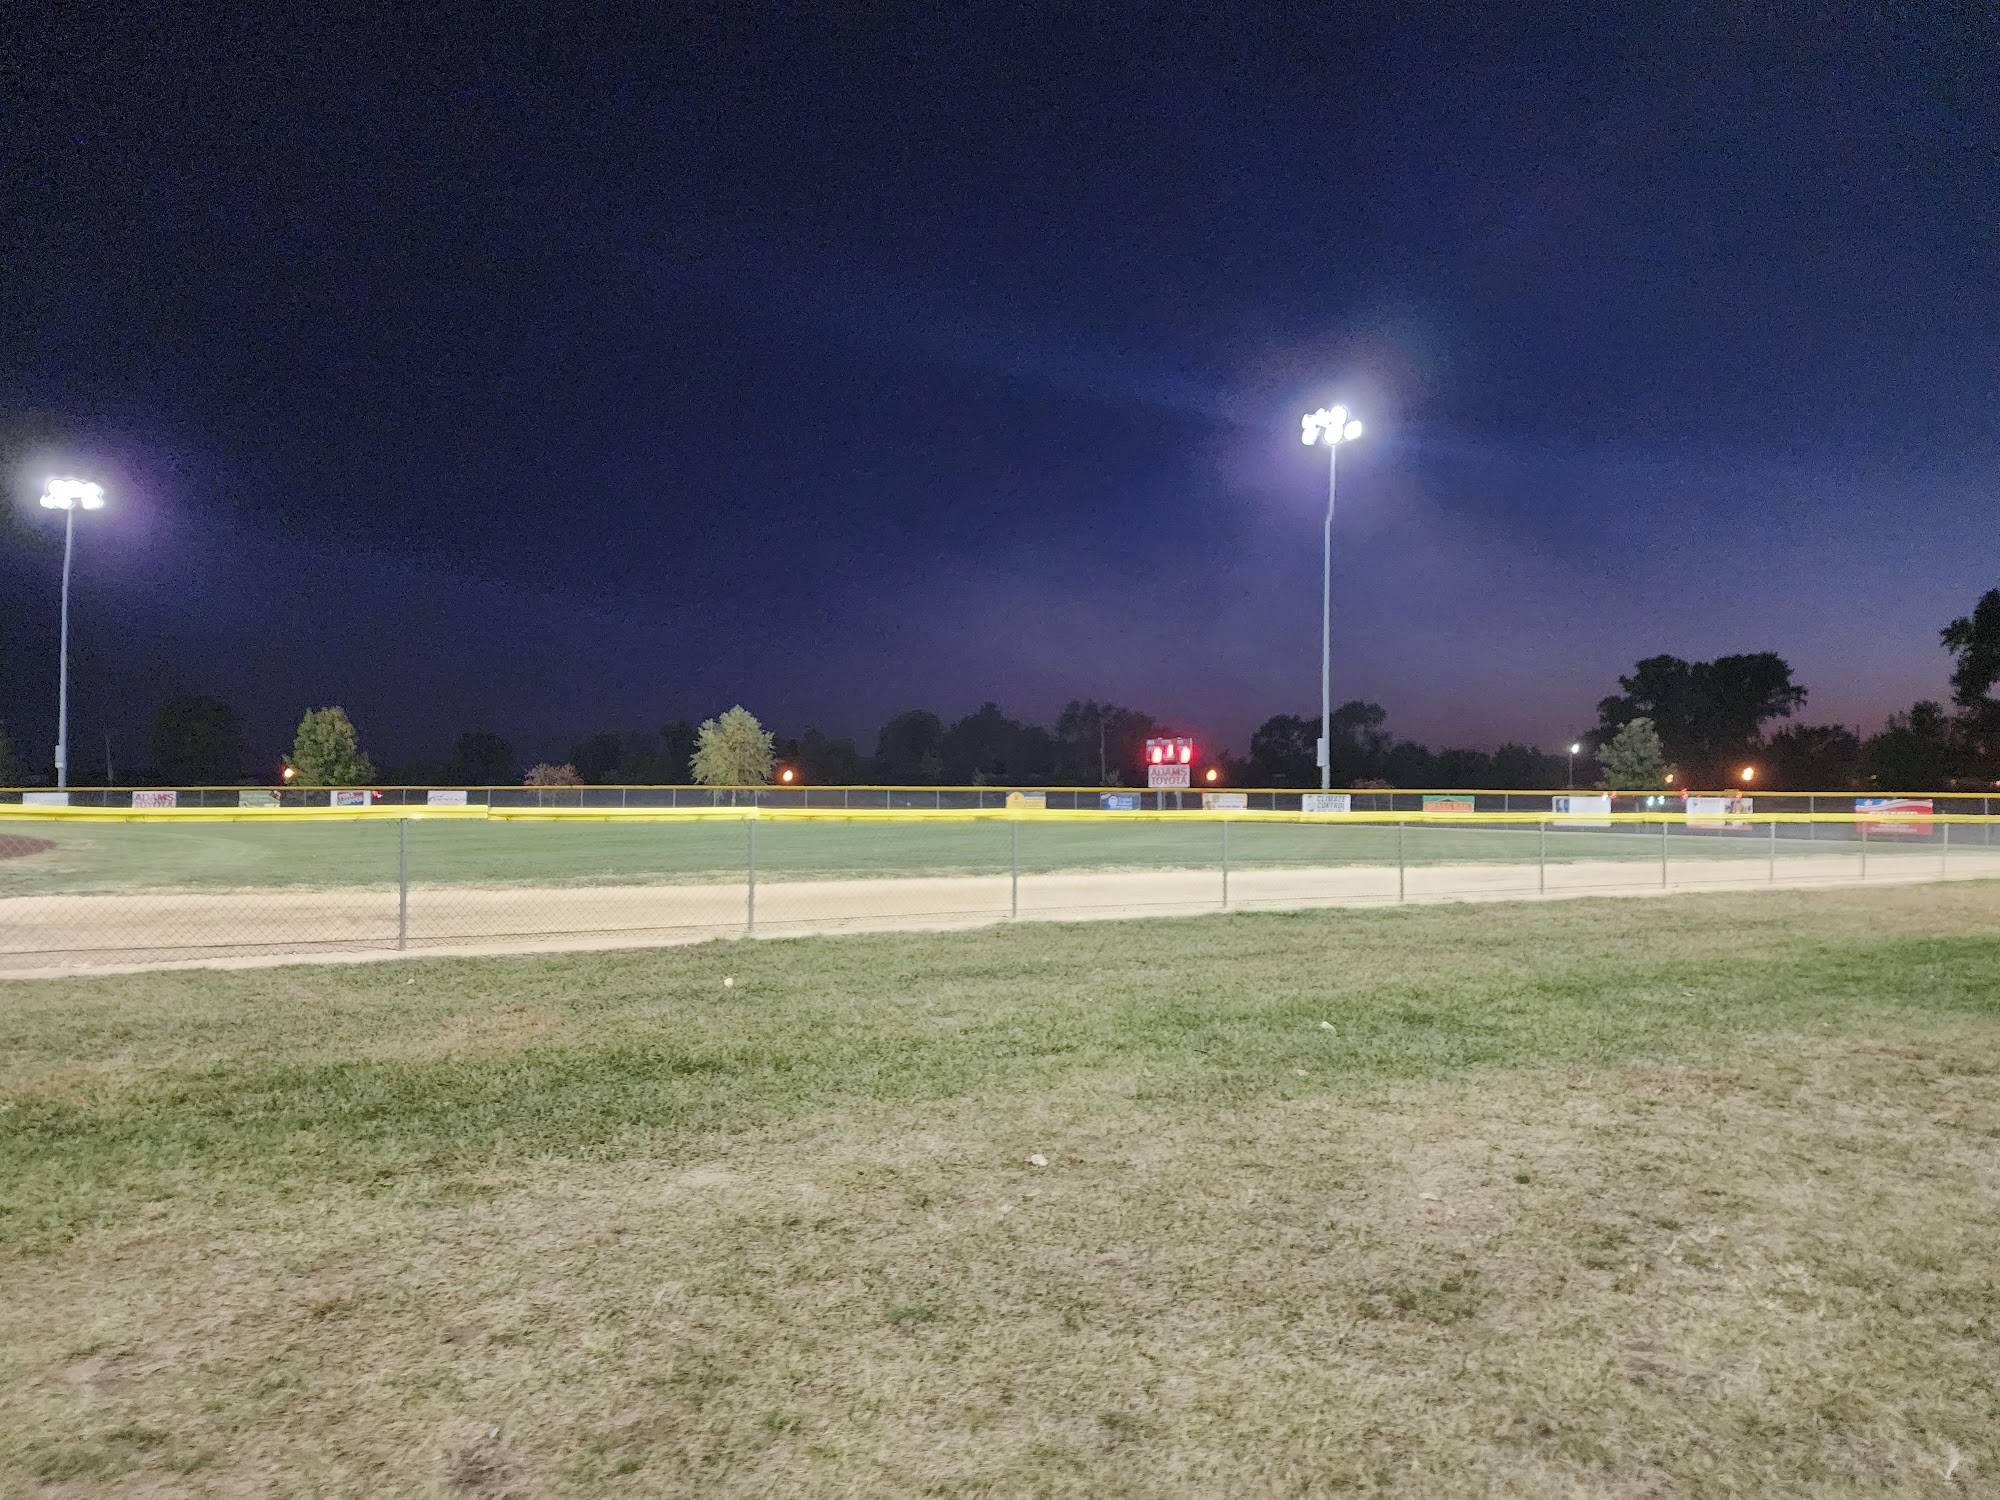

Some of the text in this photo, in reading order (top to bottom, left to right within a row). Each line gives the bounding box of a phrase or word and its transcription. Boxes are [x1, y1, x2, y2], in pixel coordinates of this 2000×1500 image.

[1151, 767, 1188, 777] ADAMS
[1151, 776, 1188, 785] TOYOTA
[135, 793, 174, 801] ADAMS
[1316, 795, 1347, 803] CLIMATE
